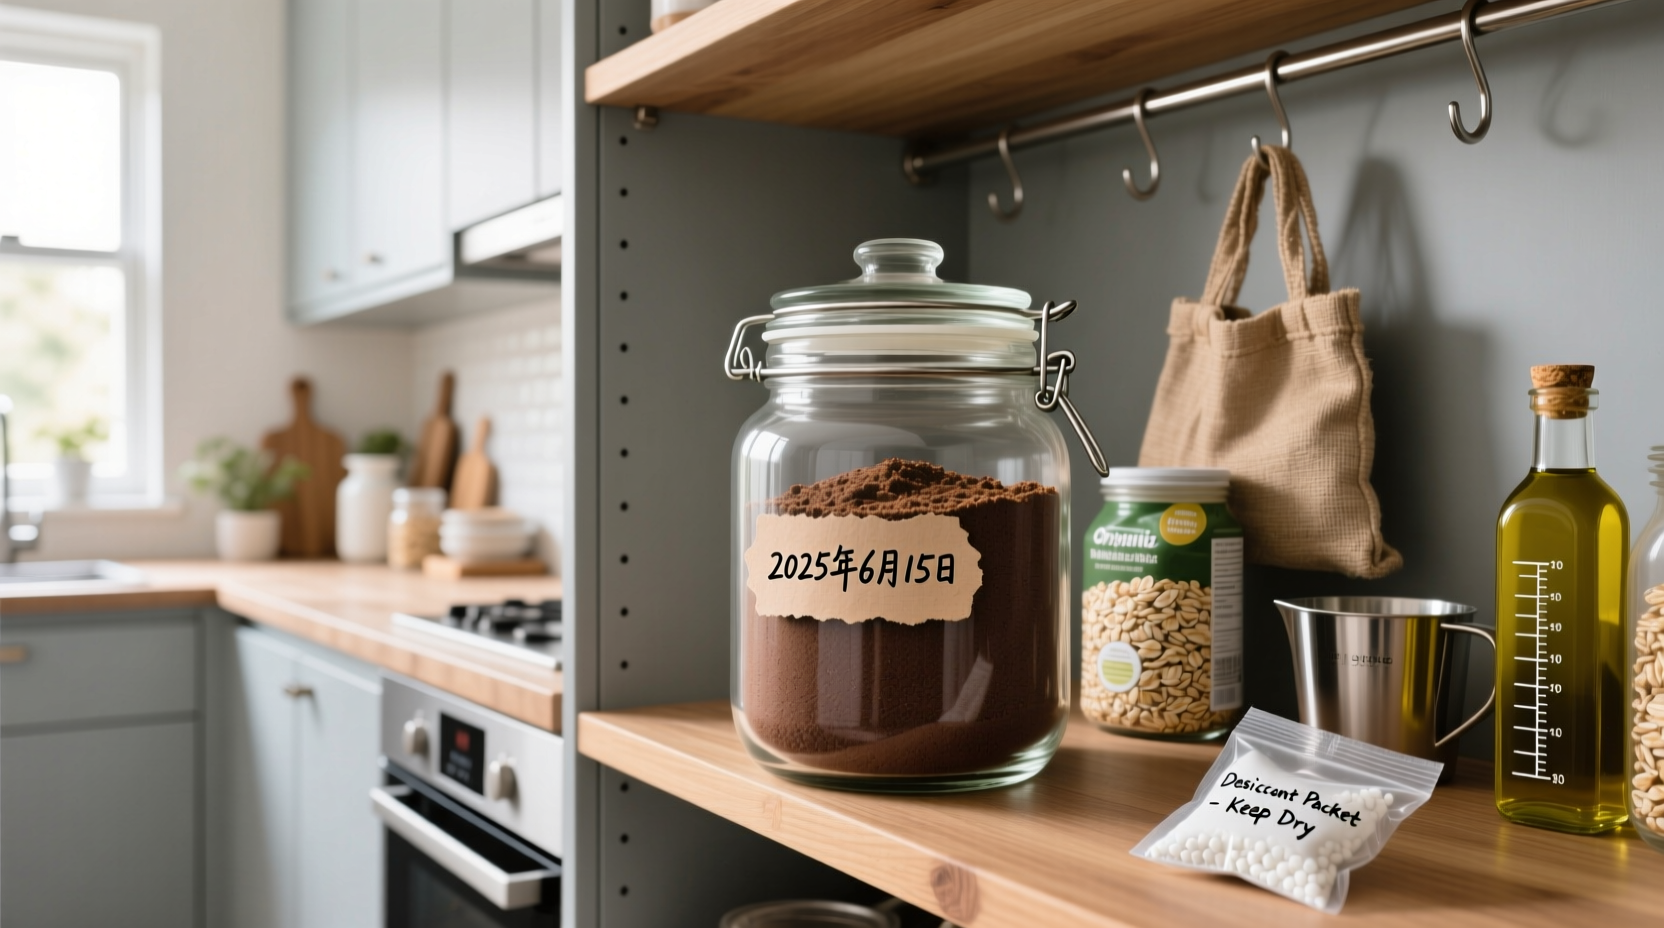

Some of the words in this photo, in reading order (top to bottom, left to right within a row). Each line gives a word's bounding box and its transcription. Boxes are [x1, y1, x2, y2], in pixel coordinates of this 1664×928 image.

[768, 544, 954, 592] 2025年6月15日
[1549, 654, 1562, 664] 10
[1549, 683, 1562, 694] 10
[1549, 727, 1562, 738] 10
[1226, 796, 1271, 825] Keep
[1277, 809, 1316, 840] Dry
[1303, 791, 1361, 827] Packet
